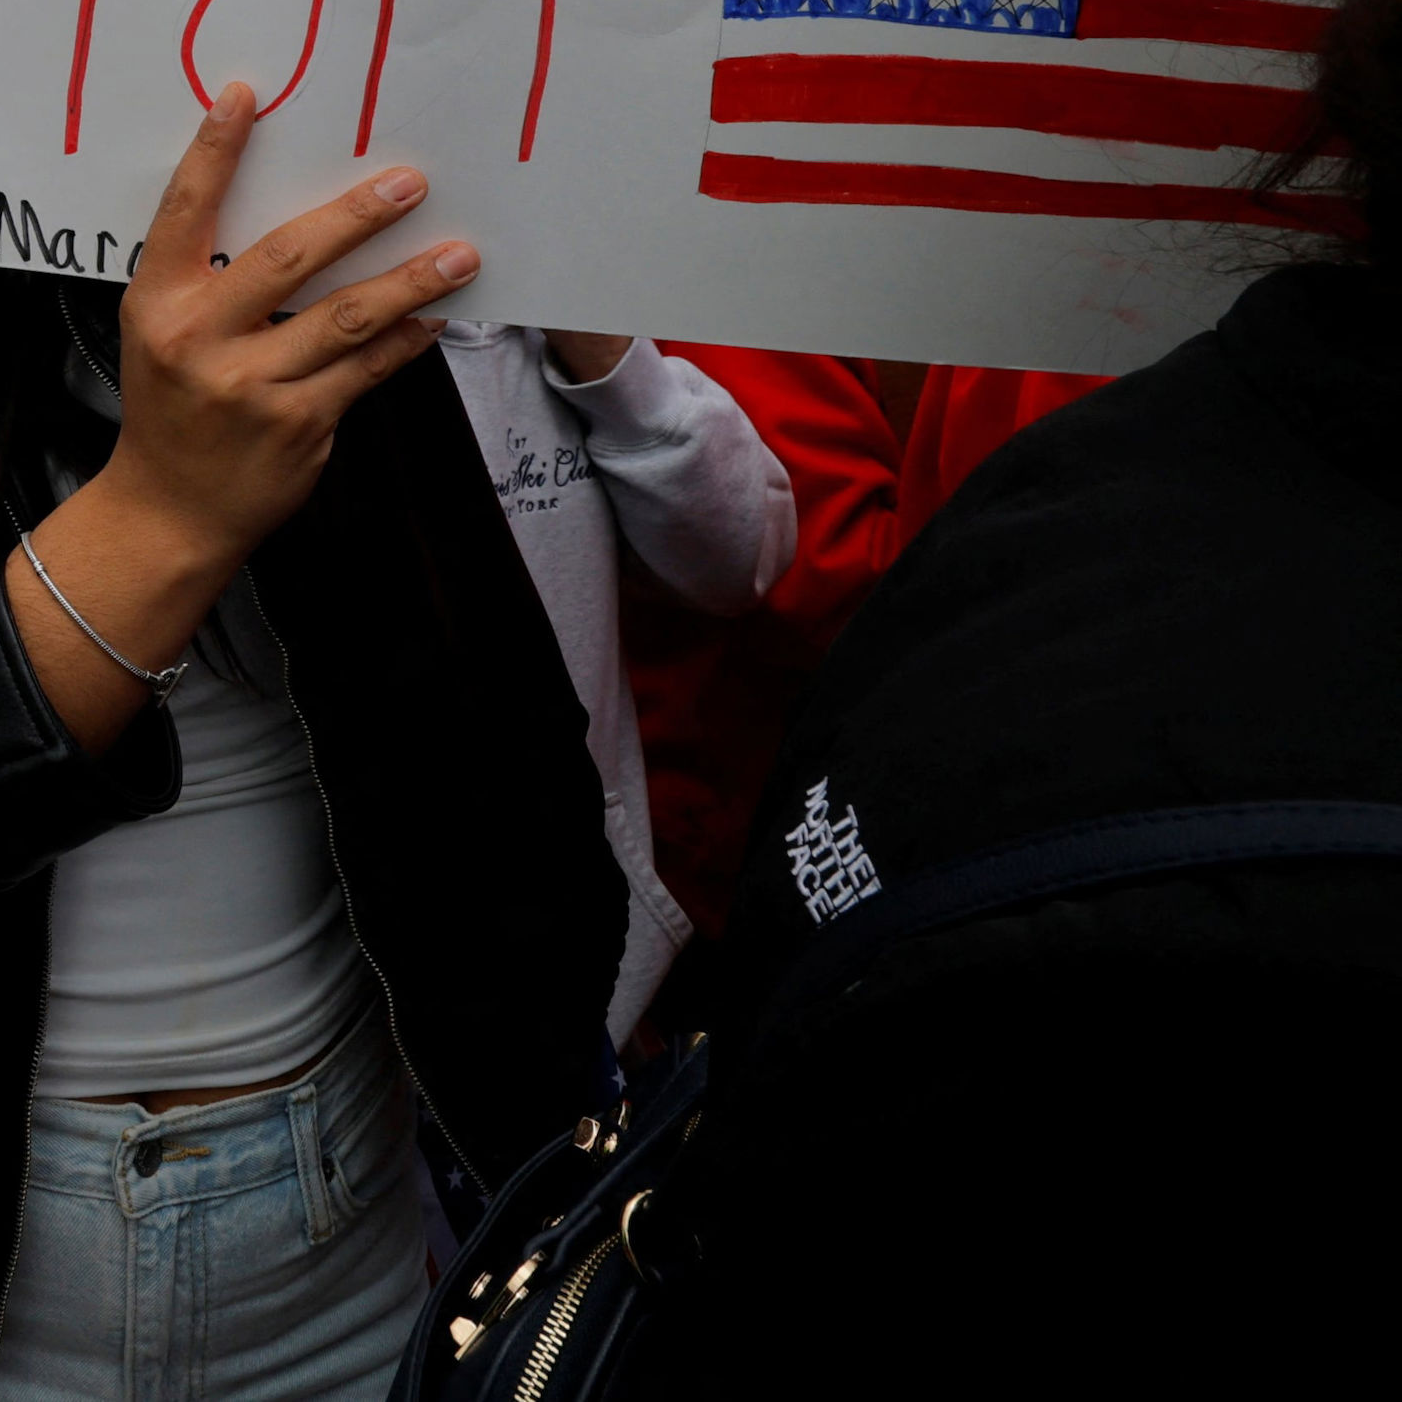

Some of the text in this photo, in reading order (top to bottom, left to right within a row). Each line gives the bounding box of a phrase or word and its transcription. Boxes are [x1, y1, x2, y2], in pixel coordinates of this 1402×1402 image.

[517, 497, 560, 514] YORK
[784, 821, 835, 925] FACE
[804, 774, 856, 908] NORTH
[831, 803, 876, 889] THE
